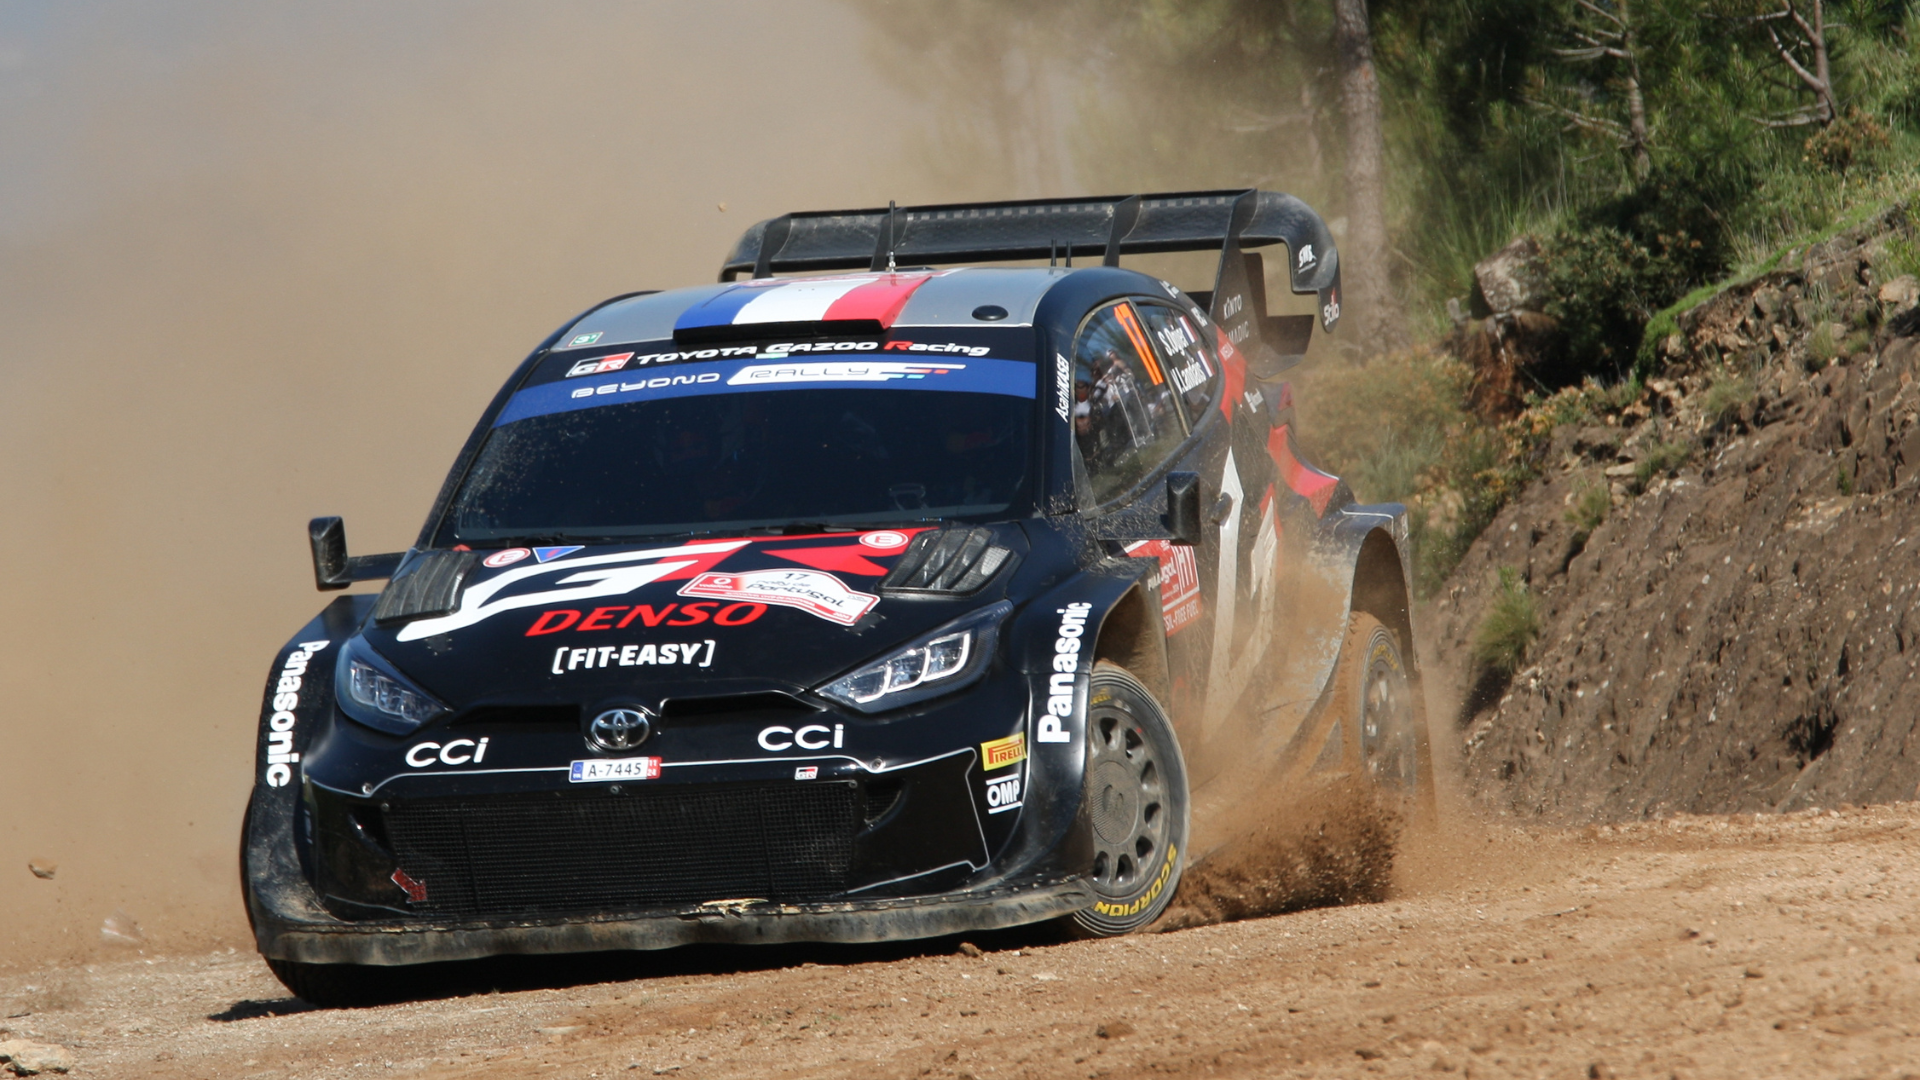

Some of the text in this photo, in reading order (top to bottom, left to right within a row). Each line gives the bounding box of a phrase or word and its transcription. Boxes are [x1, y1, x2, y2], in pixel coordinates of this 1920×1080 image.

[571, 341, 990, 376] GR TOYOTA GAZOO Racing
[1113, 303, 1164, 386] 17
[571, 367, 869, 398] BEYOND RALLY
[1055, 352, 1069, 423] AsahiKASEI
[525, 602, 767, 637] DENSO
[1037, 602, 1092, 743] Panasonic
[266, 640, 330, 788] Panasonic
[988, 739, 1024, 764] PIRELLI
[588, 762, 642, 777] A-7445
[987, 780, 1020, 807] OMP
[1094, 843, 1177, 916] SCORPION
